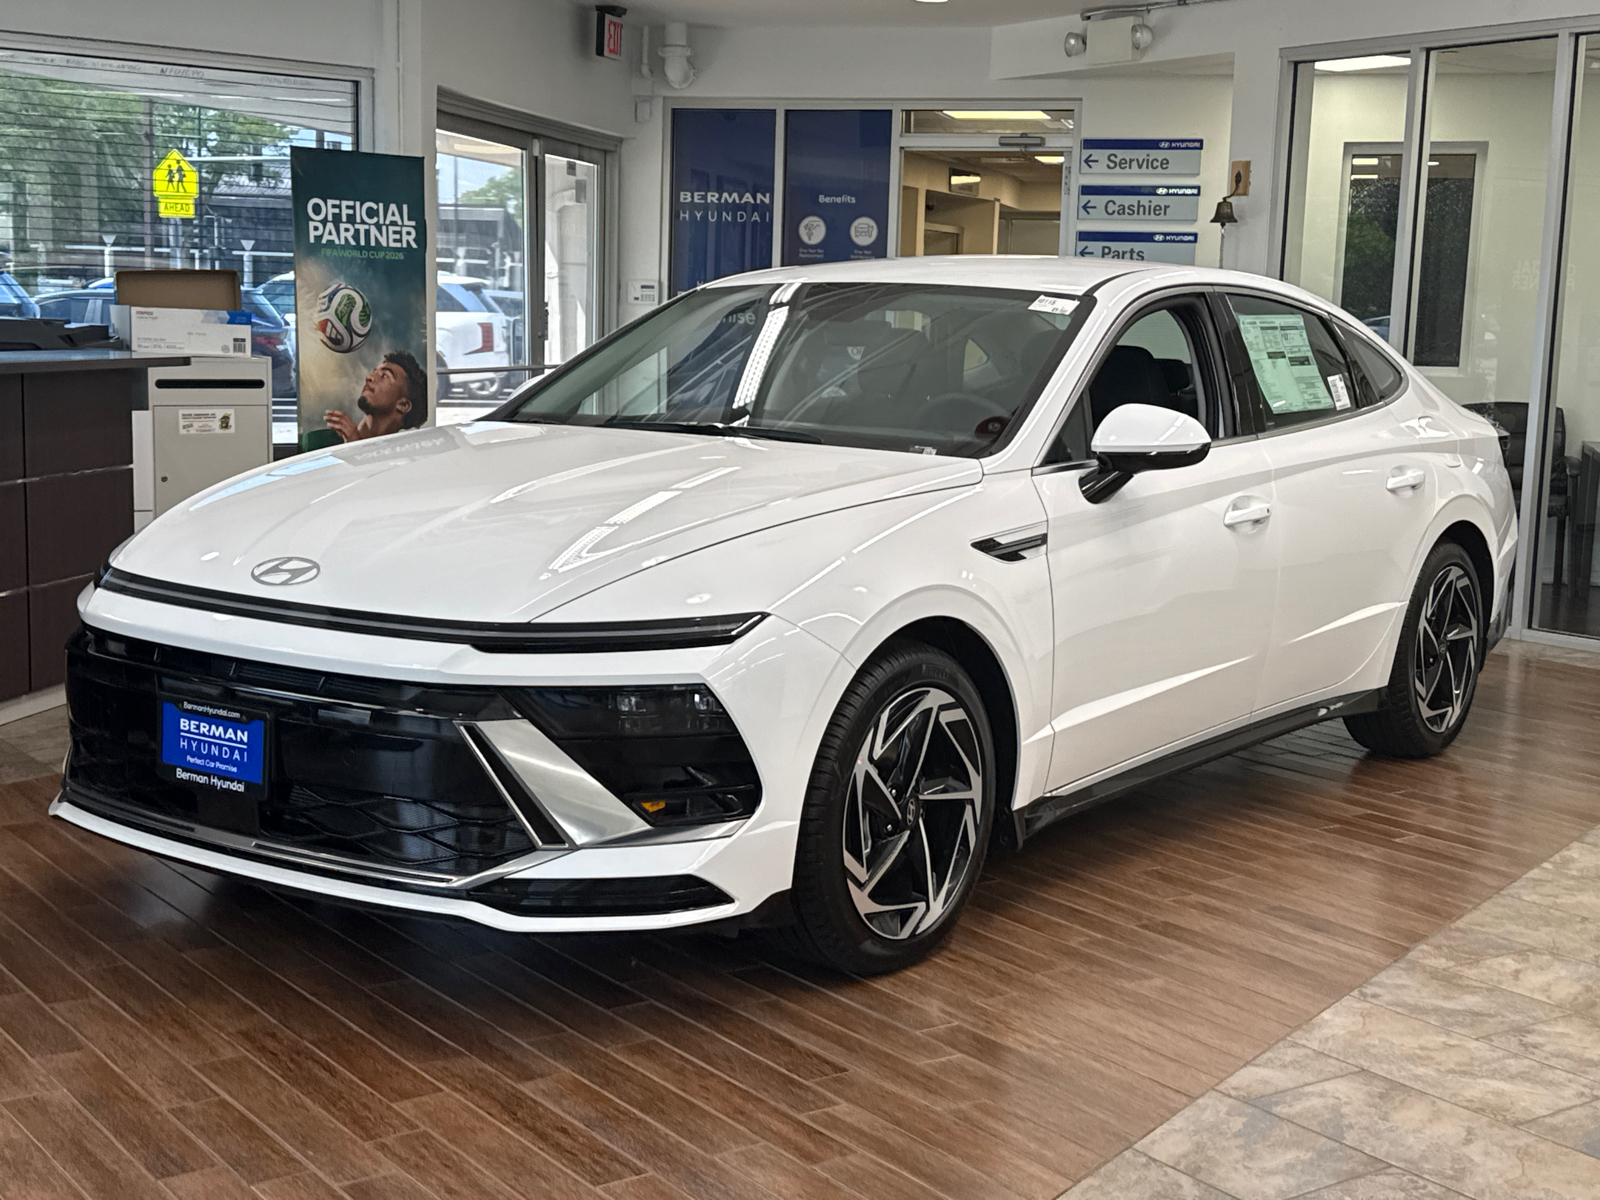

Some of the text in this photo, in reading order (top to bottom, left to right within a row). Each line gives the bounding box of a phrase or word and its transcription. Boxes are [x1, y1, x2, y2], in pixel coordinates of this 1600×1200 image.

[607, 19, 623, 56] EXIT
[1106, 153, 1170, 170] Service
[680, 191, 770, 205] BERMAN
[818, 194, 856, 204] Benefits
[1168, 187, 1199, 195] HYUNDAI
[163, 202, 191, 212] AHEAD
[307, 197, 416, 226] OFFICIAL
[1104, 199, 1170, 216] Cashier
[680, 210, 770, 222] HYUNDAI
[308, 220, 418, 249] PARTNER
[321, 247, 405, 260] FIFA WORLD CUP 2026
[1101, 246, 1145, 261] Parts
[183, 701, 241, 719] BermanHyundai.com
[180, 718, 248, 743] BERMAN
[180, 738, 248, 762] HYUNDAI
[186, 755, 238, 773] Perfect Car Promise
[176, 767, 245, 793] Berman Hyundai
